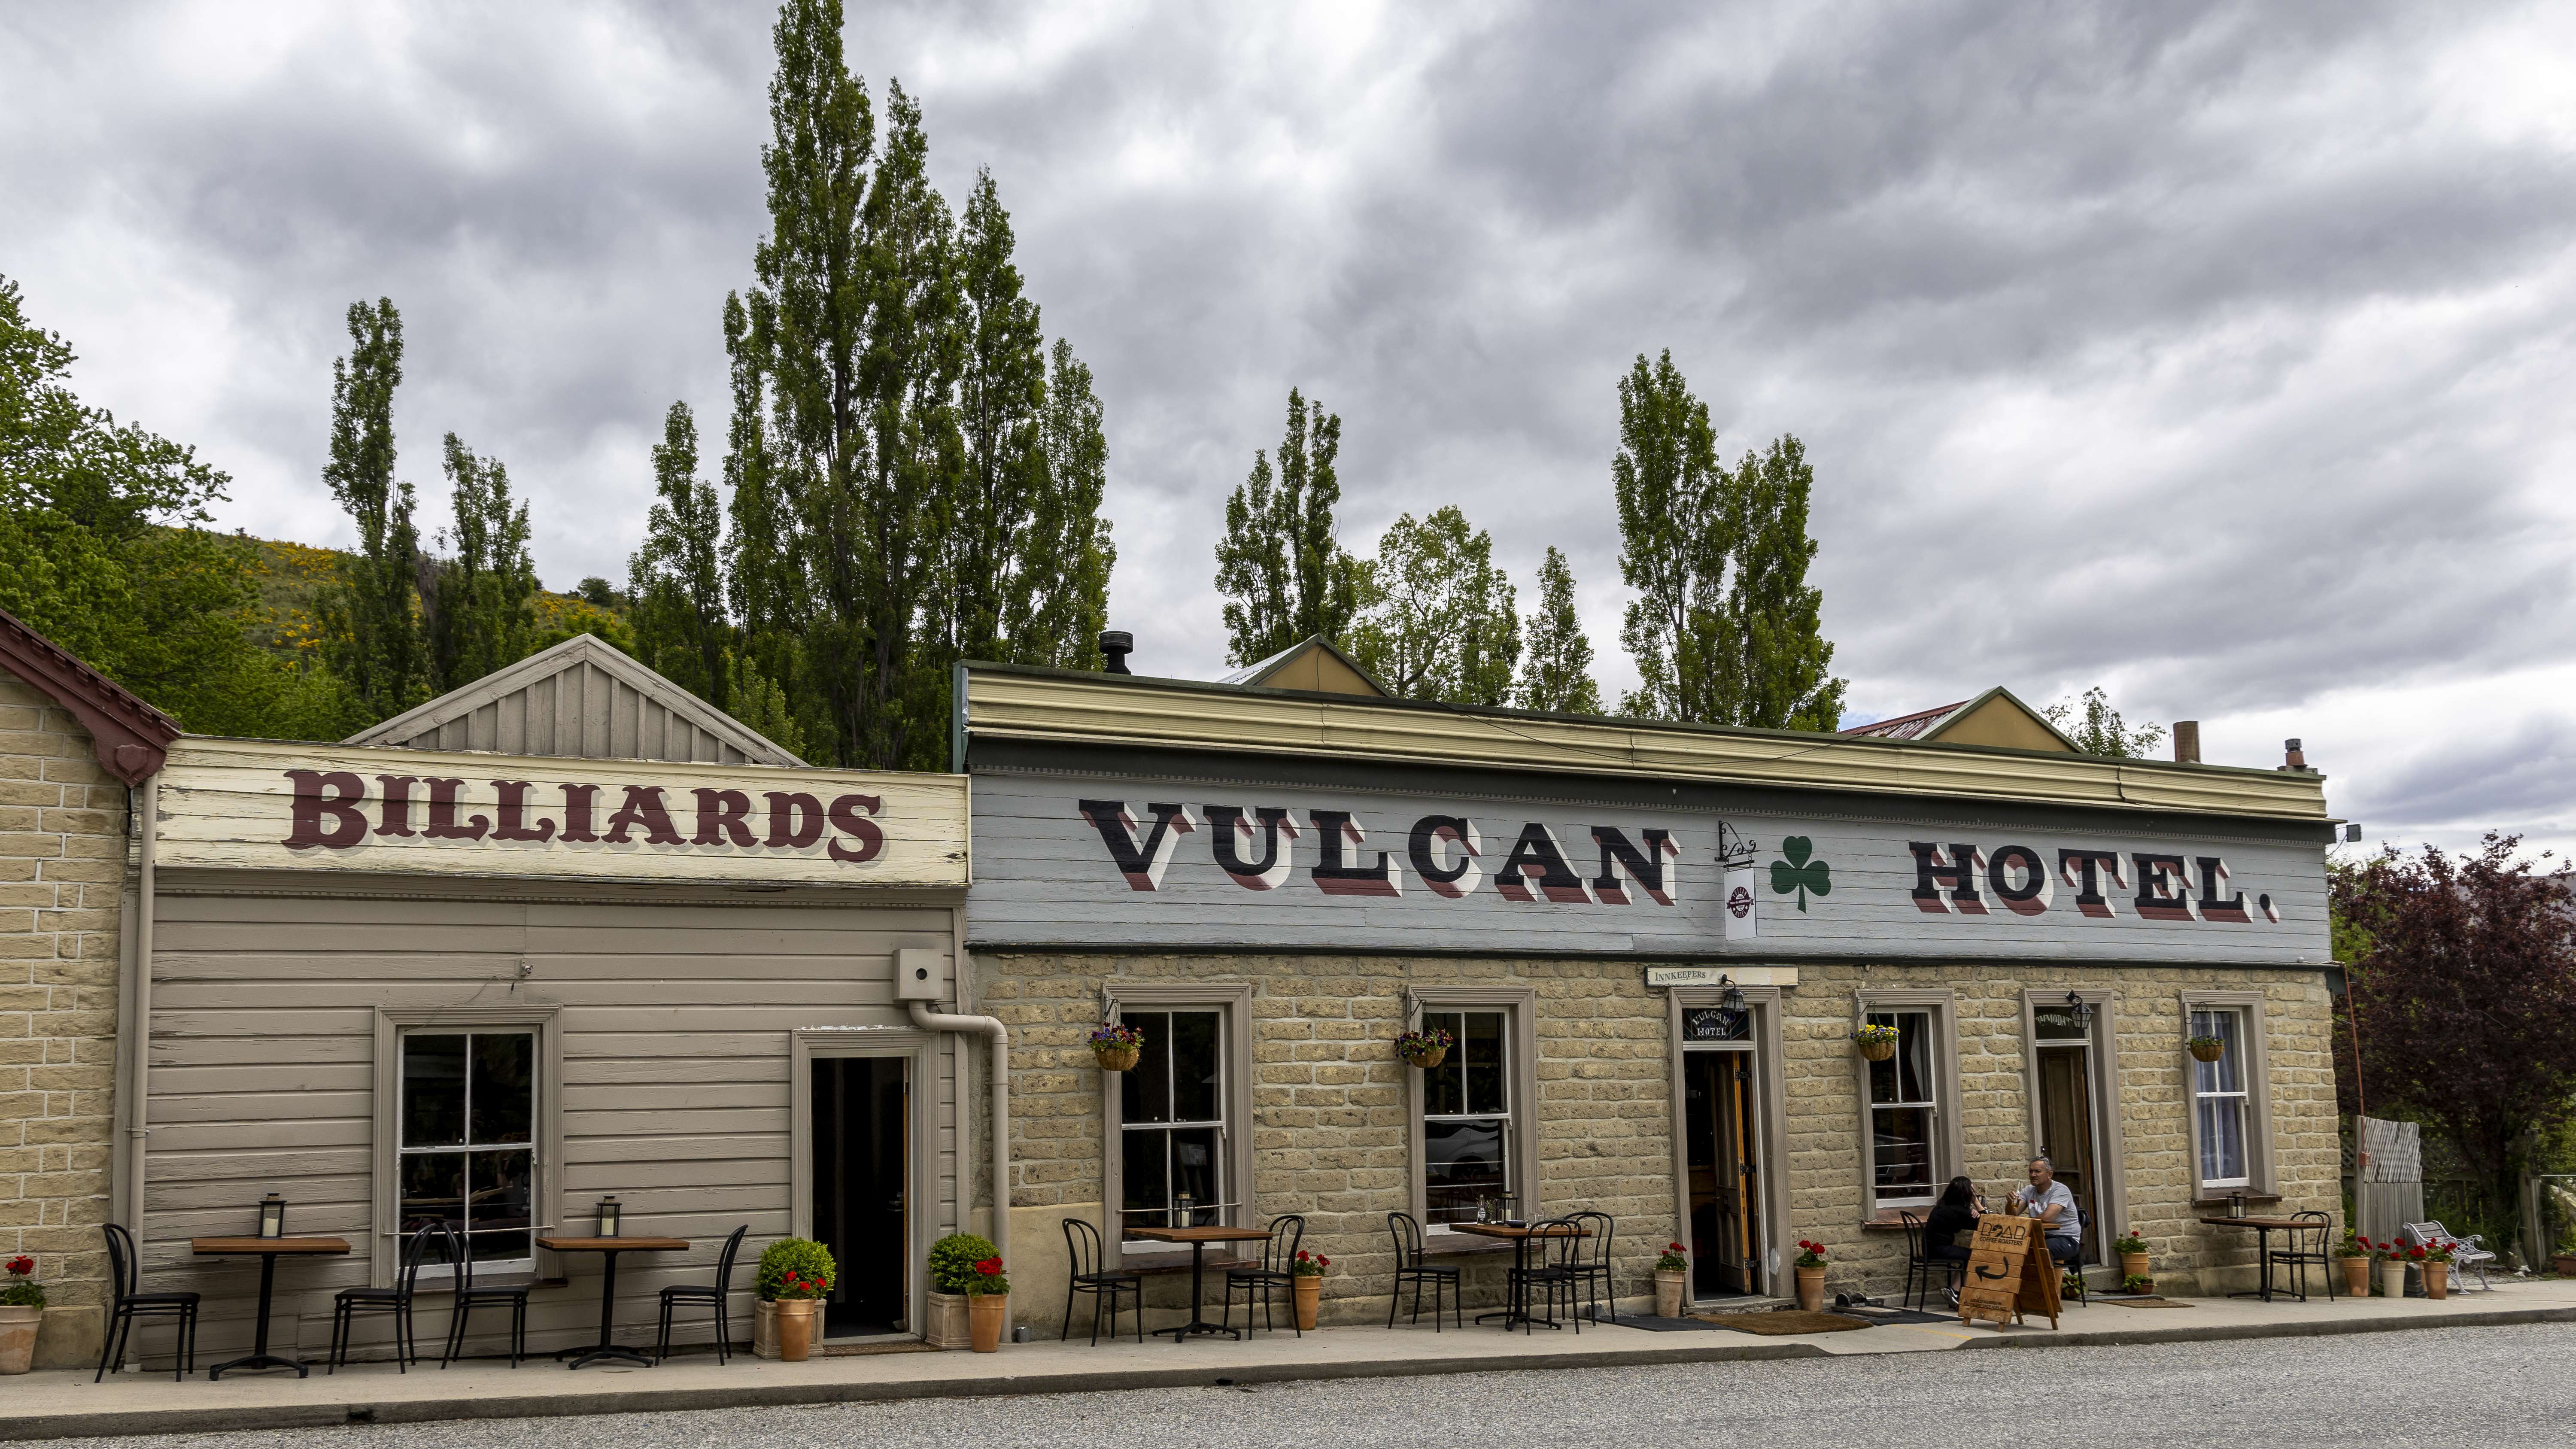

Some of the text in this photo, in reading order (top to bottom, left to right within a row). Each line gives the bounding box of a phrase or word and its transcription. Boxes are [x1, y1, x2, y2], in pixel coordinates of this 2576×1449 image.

[281, 771, 882, 863] BILLIARDS
[1078, 799, 1680, 906] VULCAN
[1732, 887, 1747, 898] VULCAN
[1692, 1010, 1729, 1025] VULCAN
